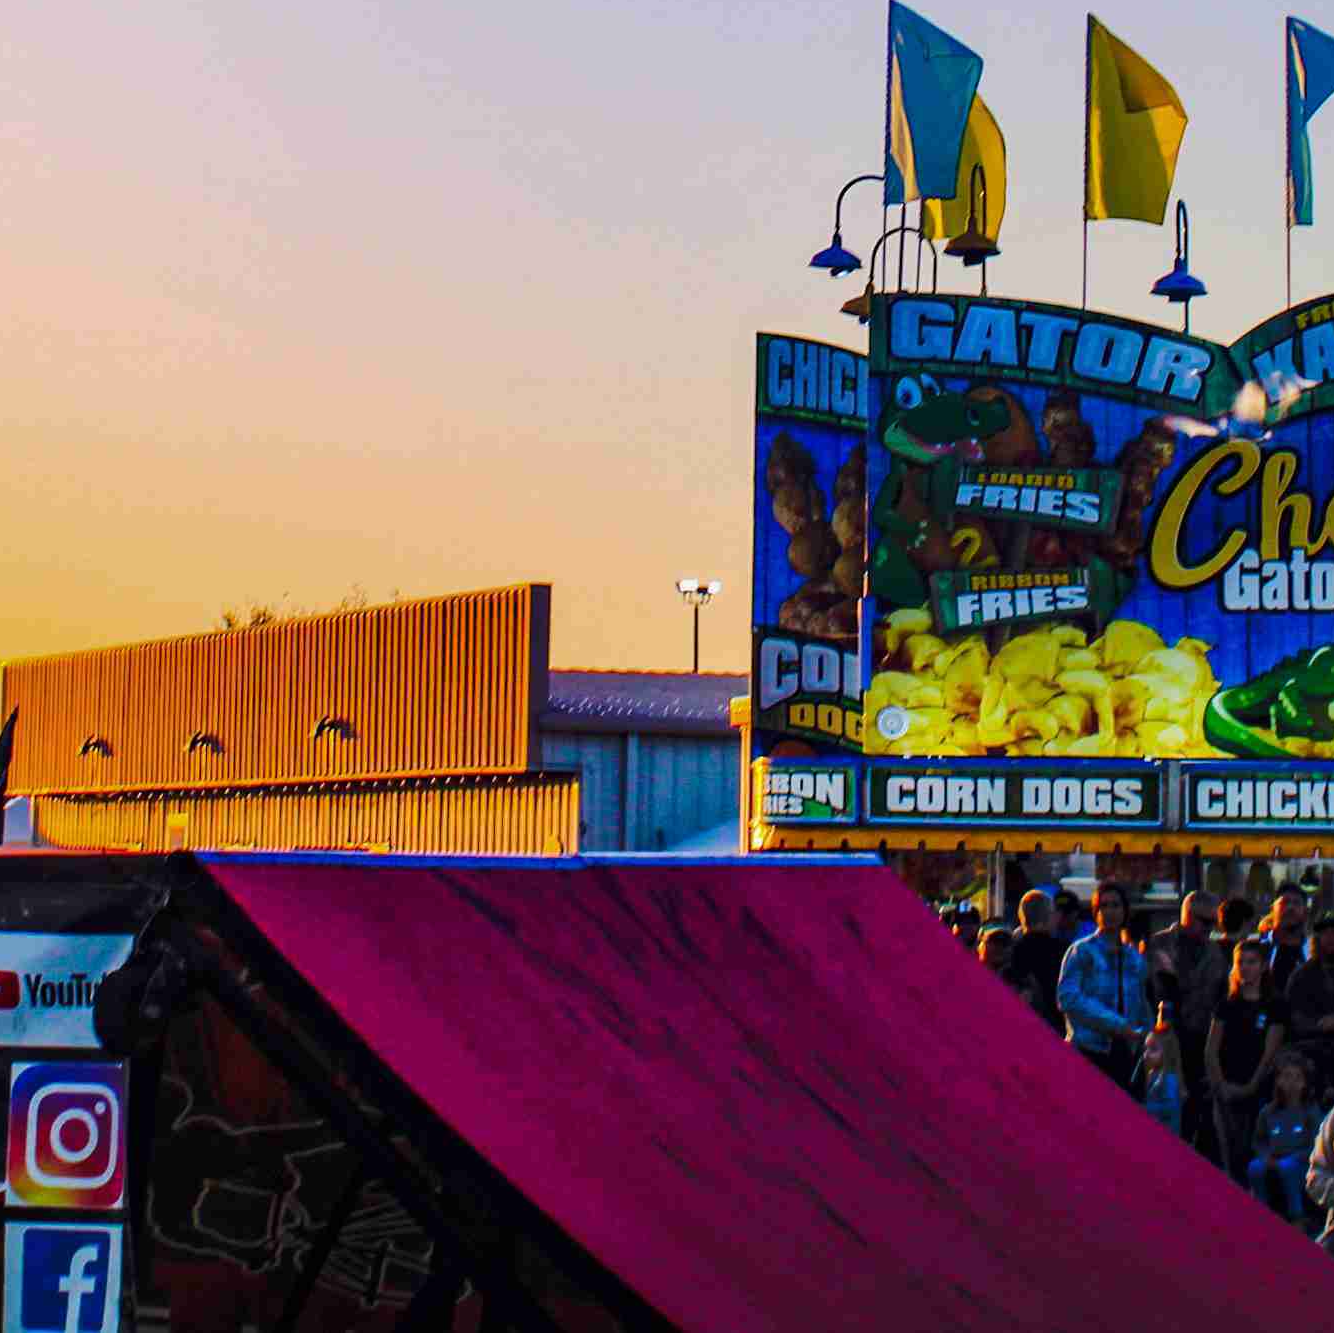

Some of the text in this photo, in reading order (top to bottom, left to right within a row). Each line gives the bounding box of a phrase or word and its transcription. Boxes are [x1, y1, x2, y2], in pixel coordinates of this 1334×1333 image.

[890, 299, 1212, 402] GATOR
[955, 483, 1100, 523] FRIES
[956, 585, 1089, 626] FRIES
[886, 776, 1143, 815] CORN DOGS
[24, 972, 107, 1008] YouTu
